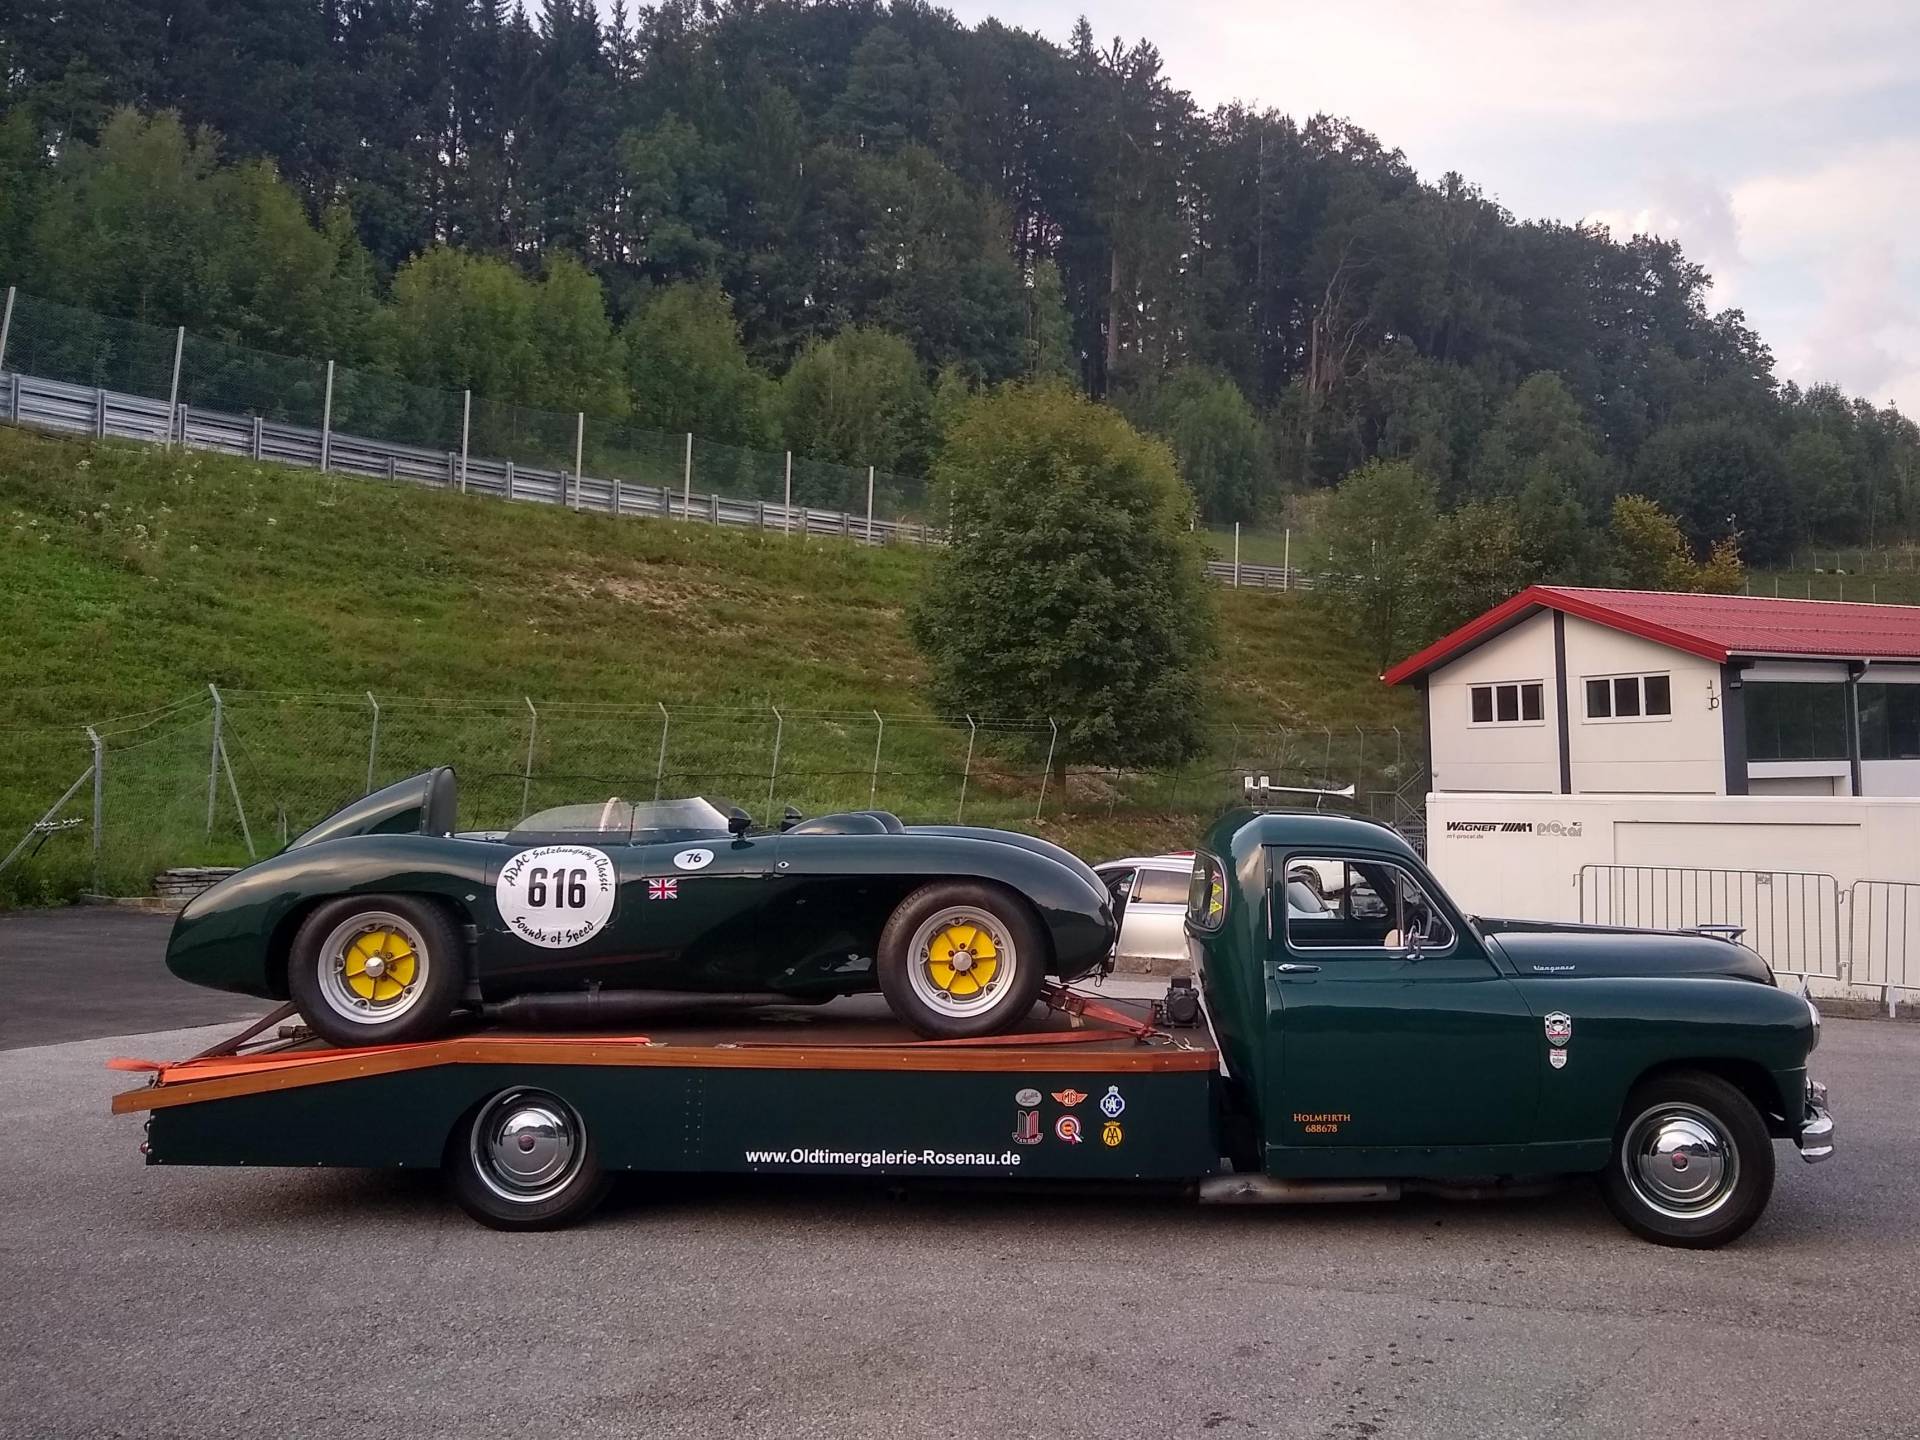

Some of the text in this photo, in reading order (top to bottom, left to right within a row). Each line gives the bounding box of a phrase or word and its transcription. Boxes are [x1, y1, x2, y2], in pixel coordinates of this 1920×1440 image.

[1446, 821, 1497, 832] WAGNER
[685, 852, 702, 864] 76
[503, 854, 531, 887] ADAC
[594, 858, 610, 893] Classic
[527, 867, 588, 909] 616
[511, 916, 594, 945] Sounds of Speed
[1063, 1092, 1076, 1103] MG
[1105, 1096, 1120, 1112] RAC
[1293, 1113, 1351, 1122] HOLMFIRTH
[1105, 1127, 1120, 1144] AA
[1305, 1124, 1338, 1133] 688678
[745, 1148, 1021, 1168] www.Oldtimergalerie-Rosenau.de
